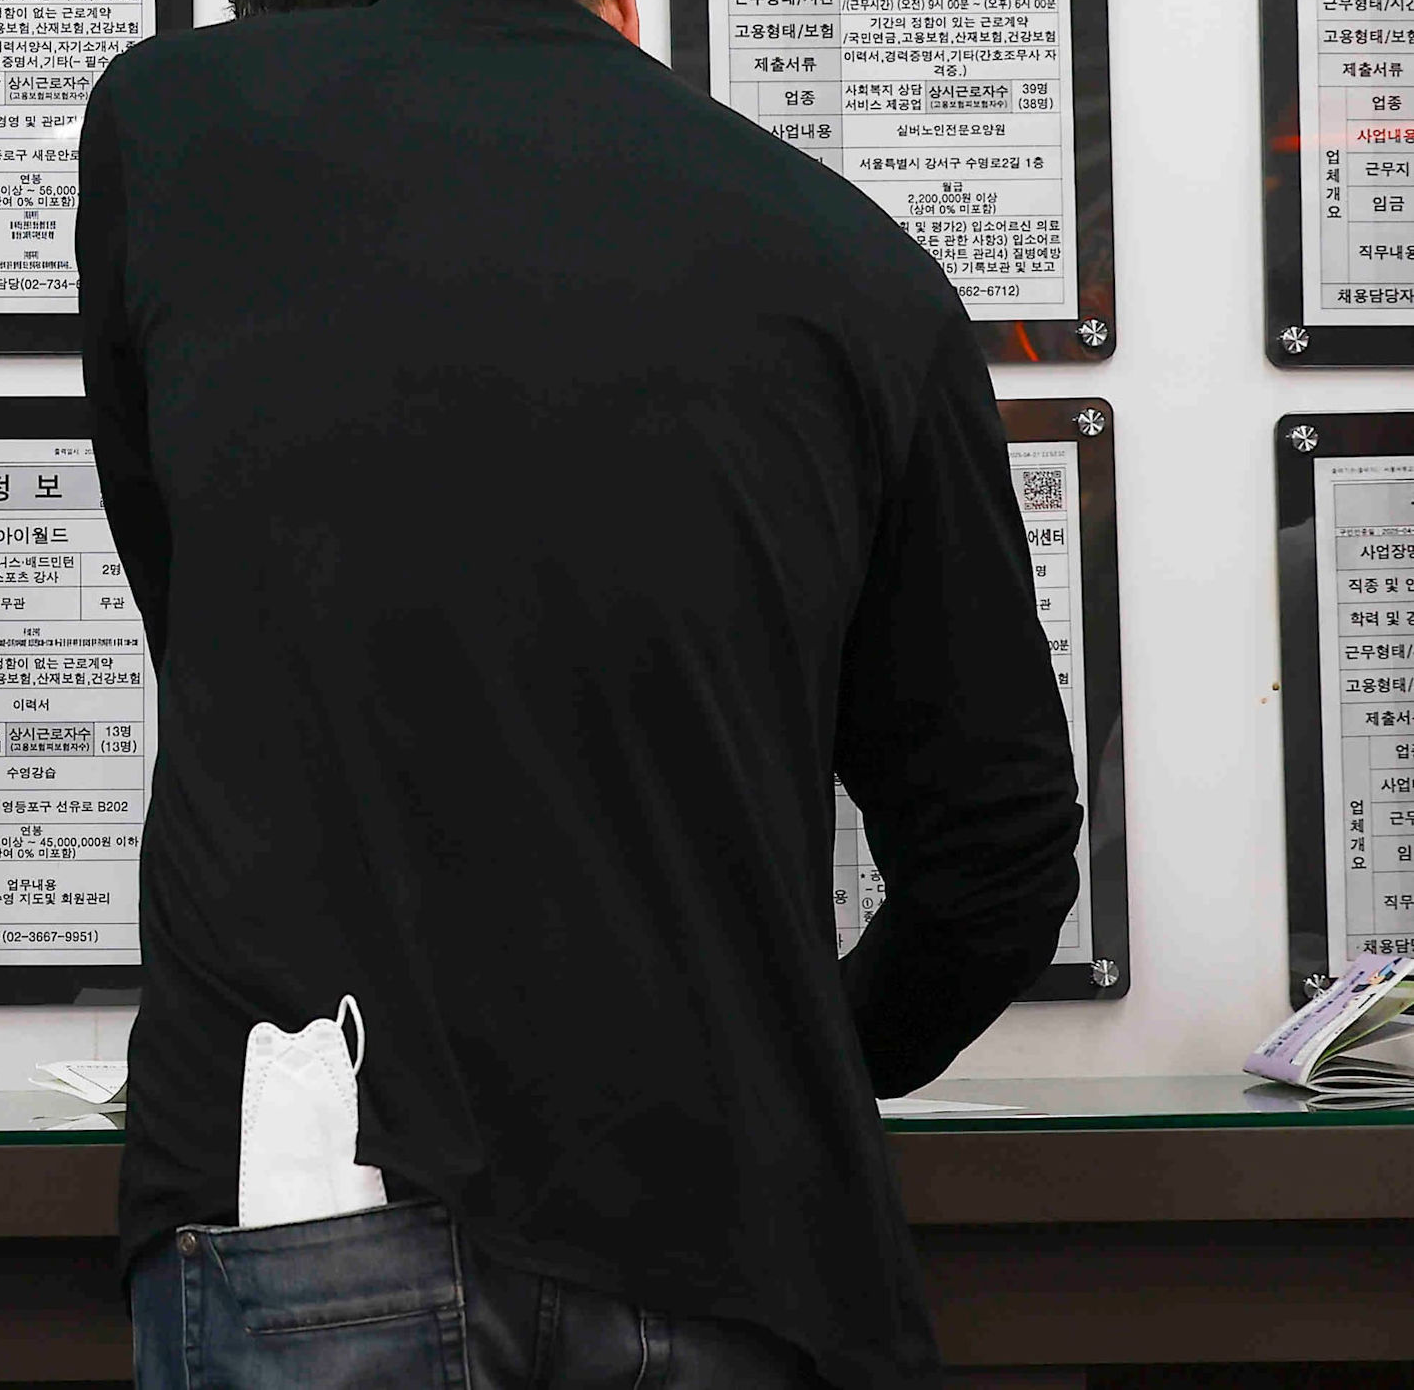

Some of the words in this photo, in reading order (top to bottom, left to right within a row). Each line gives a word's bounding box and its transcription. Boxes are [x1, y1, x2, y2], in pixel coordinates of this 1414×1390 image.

[1342, 61, 1404, 78] 제출서류
[845, 83, 893, 97] 사회복지
[1022, 82, 1048, 95] 39명
[896, 123, 1006, 137] 실버노인전문요양원
[924, 157, 962, 170] 강서구
[1372, 195, 1405, 212] 임금
[33, 570, 59, 584] 강사
[6, 766, 57, 780] 수영강습
[2, 800, 52, 814] 영등포구
[56, 800, 94, 814] 선유로
[97, 801, 129, 813] B202
[60, 891, 110, 906] 회원관리
